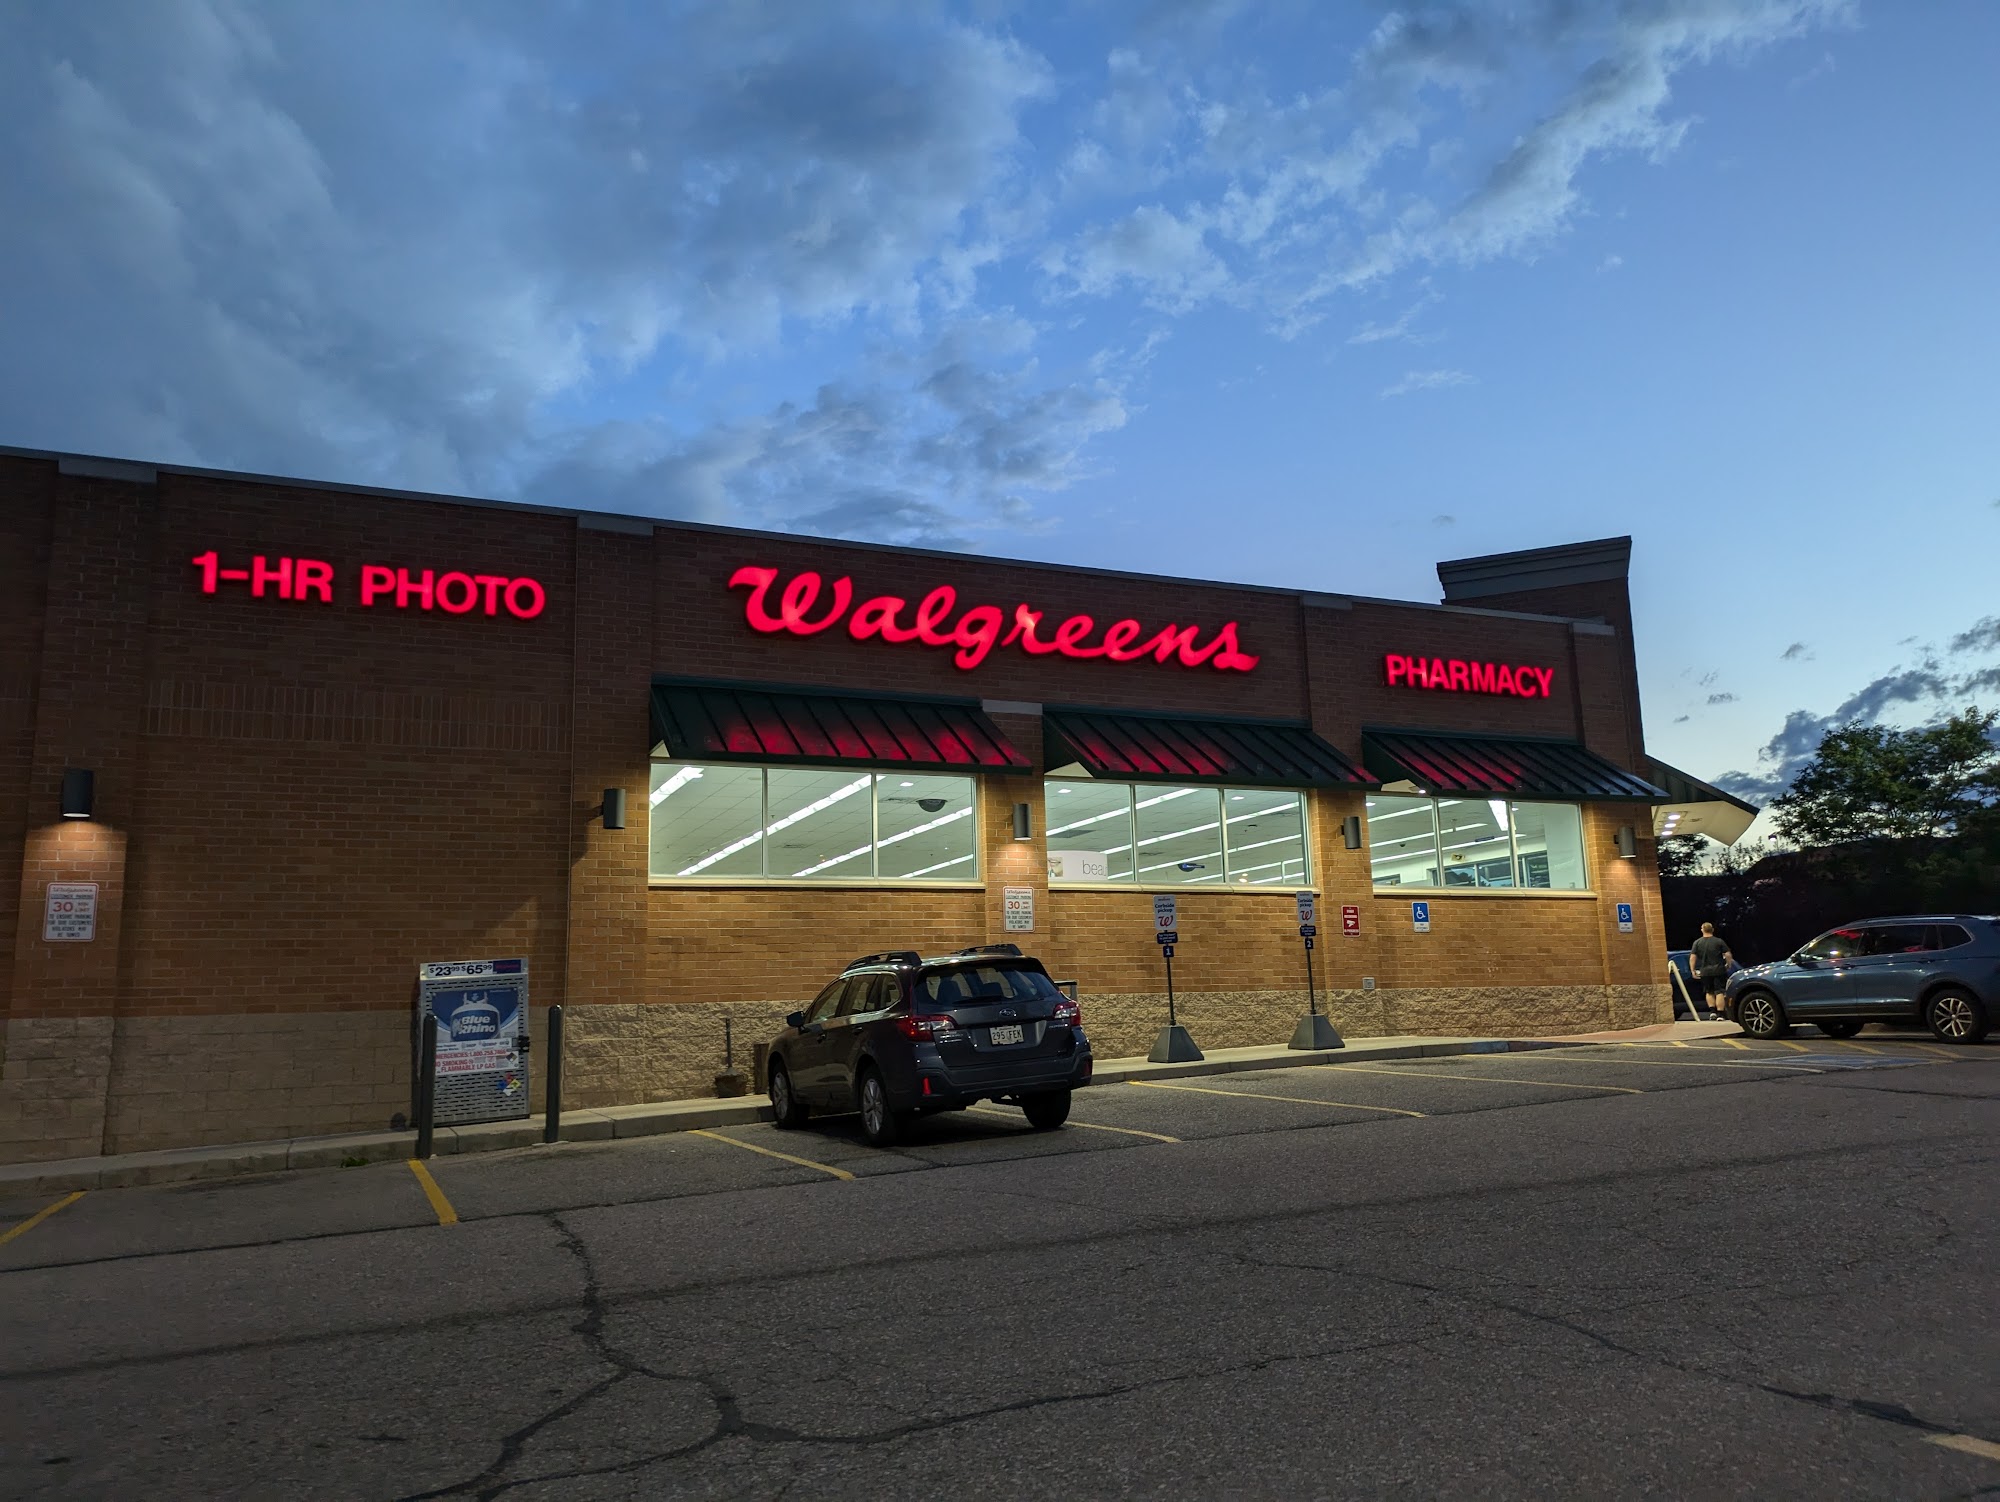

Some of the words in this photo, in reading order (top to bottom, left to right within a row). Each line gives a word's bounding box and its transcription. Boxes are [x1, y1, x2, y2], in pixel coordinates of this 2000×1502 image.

[193, 551, 334, 601] 1-HR
[361, 565, 545, 618] PHOTO
[729, 566, 1257, 671] Walgreens
[1386, 654, 1553, 698] PHARMACY
[53, 901, 74, 912] 30
[1008, 901, 1020, 909] 30
[1306, 940, 1312, 948] 2
[1166, 948, 1171, 956] 1
[462, 1015, 491, 1024] Blue
[458, 1024, 496, 1034] Rhino
